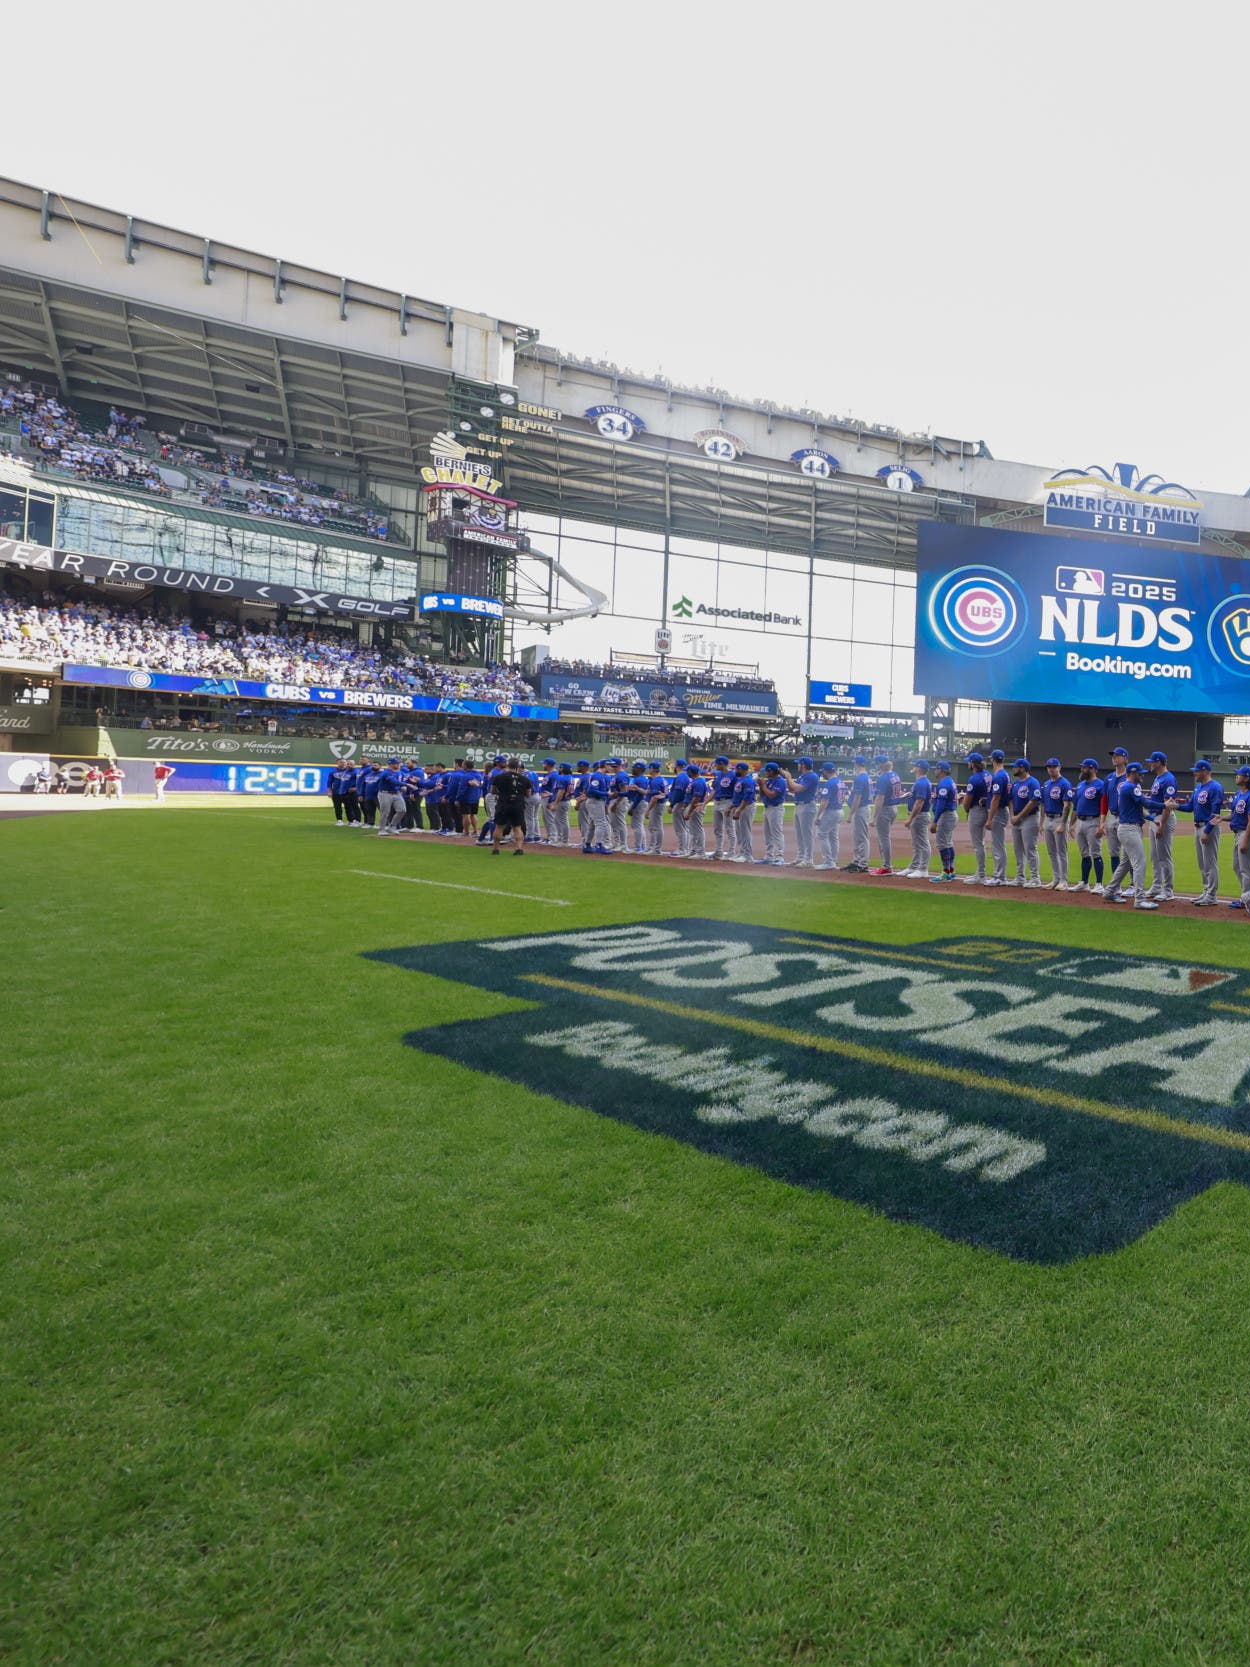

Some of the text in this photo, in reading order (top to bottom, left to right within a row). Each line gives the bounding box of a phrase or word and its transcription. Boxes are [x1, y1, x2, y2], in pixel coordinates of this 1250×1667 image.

[517, 401, 562, 421] GONE!
[595, 405, 637, 421] FINGERS
[501, 422, 528, 434] HERE
[502, 416, 554, 433] GET OUTTA
[601, 417, 630, 437] 34
[478, 433, 515, 446] GET UP
[466, 446, 503, 459] GET UP
[707, 440, 733, 457] 42
[803, 449, 829, 460] AARON
[434, 456, 492, 475] BERNIE'S
[803, 459, 827, 475] 44
[889, 464, 912, 474] SELIG
[420, 466, 504, 494] CHALET
[896, 477, 904, 489] 1
[1046, 491, 1199, 525] AMERICAN FAMILY
[1093, 514, 1156, 535] FIELD
[107, 560, 234, 593] ROUND
[1111, 582, 1176, 601] 2025
[293, 588, 410, 616] X GOLF
[696, 603, 802, 627] Associated Bank
[1039, 595, 1195, 652] NLDS
[1066, 652, 1192, 679] Booking.com
[266, 683, 413, 708] CUBS vs BREWERS
[831, 684, 849, 693] CUBS
[682, 694, 724, 706] Miller
[726, 703, 769, 713] MILWAUKEE
[581, 705, 603, 713] GREAT
[243, 740, 291, 751] Handmade
[362, 744, 420, 756] FANDUEL
[609, 744, 670, 760] Johnsonville
[228, 766, 320, 793] 12:50
[524, 1019, 1048, 1184] Booking.com
